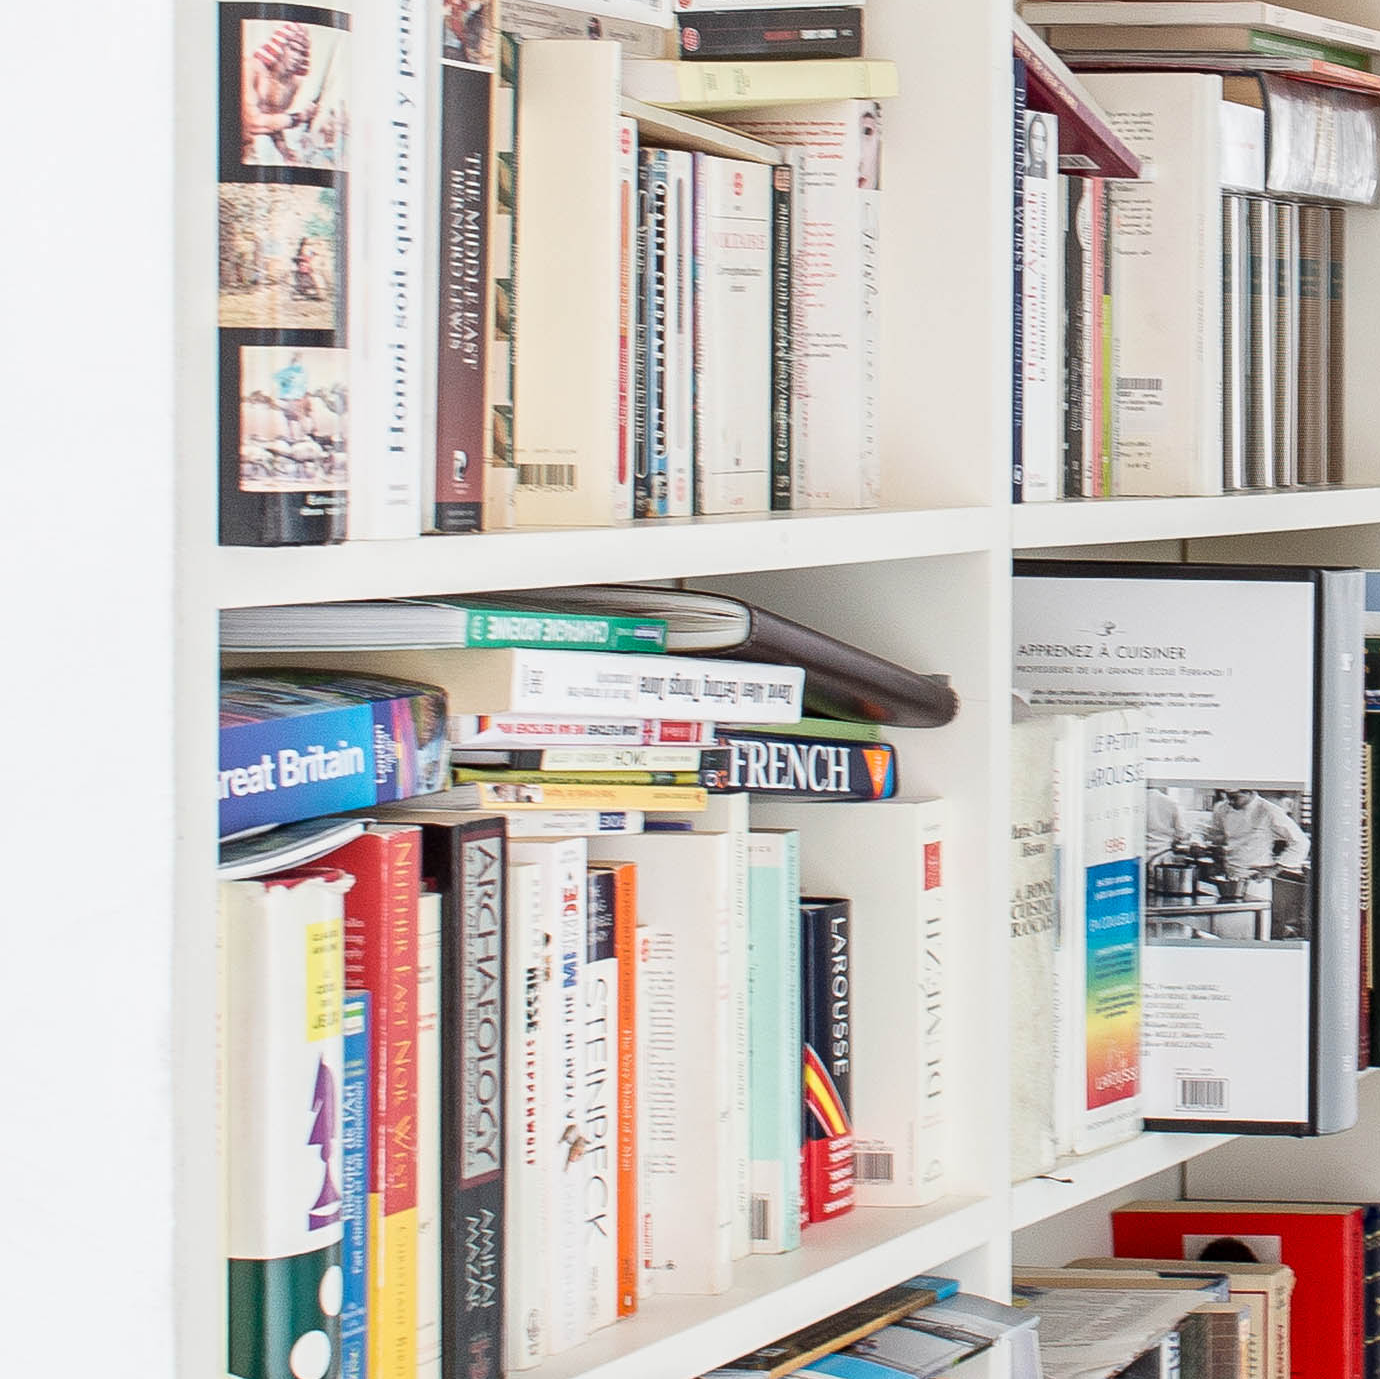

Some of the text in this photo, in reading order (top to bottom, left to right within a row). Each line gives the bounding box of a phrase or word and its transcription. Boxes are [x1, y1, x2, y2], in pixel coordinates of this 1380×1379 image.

[389, 119, 409, 185] mal
[393, 197, 413, 256] qui
[449, 168, 465, 278] BERNARD
[463, 151, 482, 371] THE MIDDLE EAST
[388, 266, 408, 330] soit
[386, 340, 408, 456] Honni
[1016, 642, 1187, 660] APPRENEZ À CUISINER
[278, 740, 365, 788] Britain
[729, 740, 852, 792] FRENCH
[475, 844, 498, 1164] ARCHAEOLOGY
[524, 965, 541, 1035] HESSE
[831, 917, 849, 1078] LAROUSSE
[583, 977, 611, 1241] STEINBECK
[481, 1208, 495, 1310] AMIHAI
